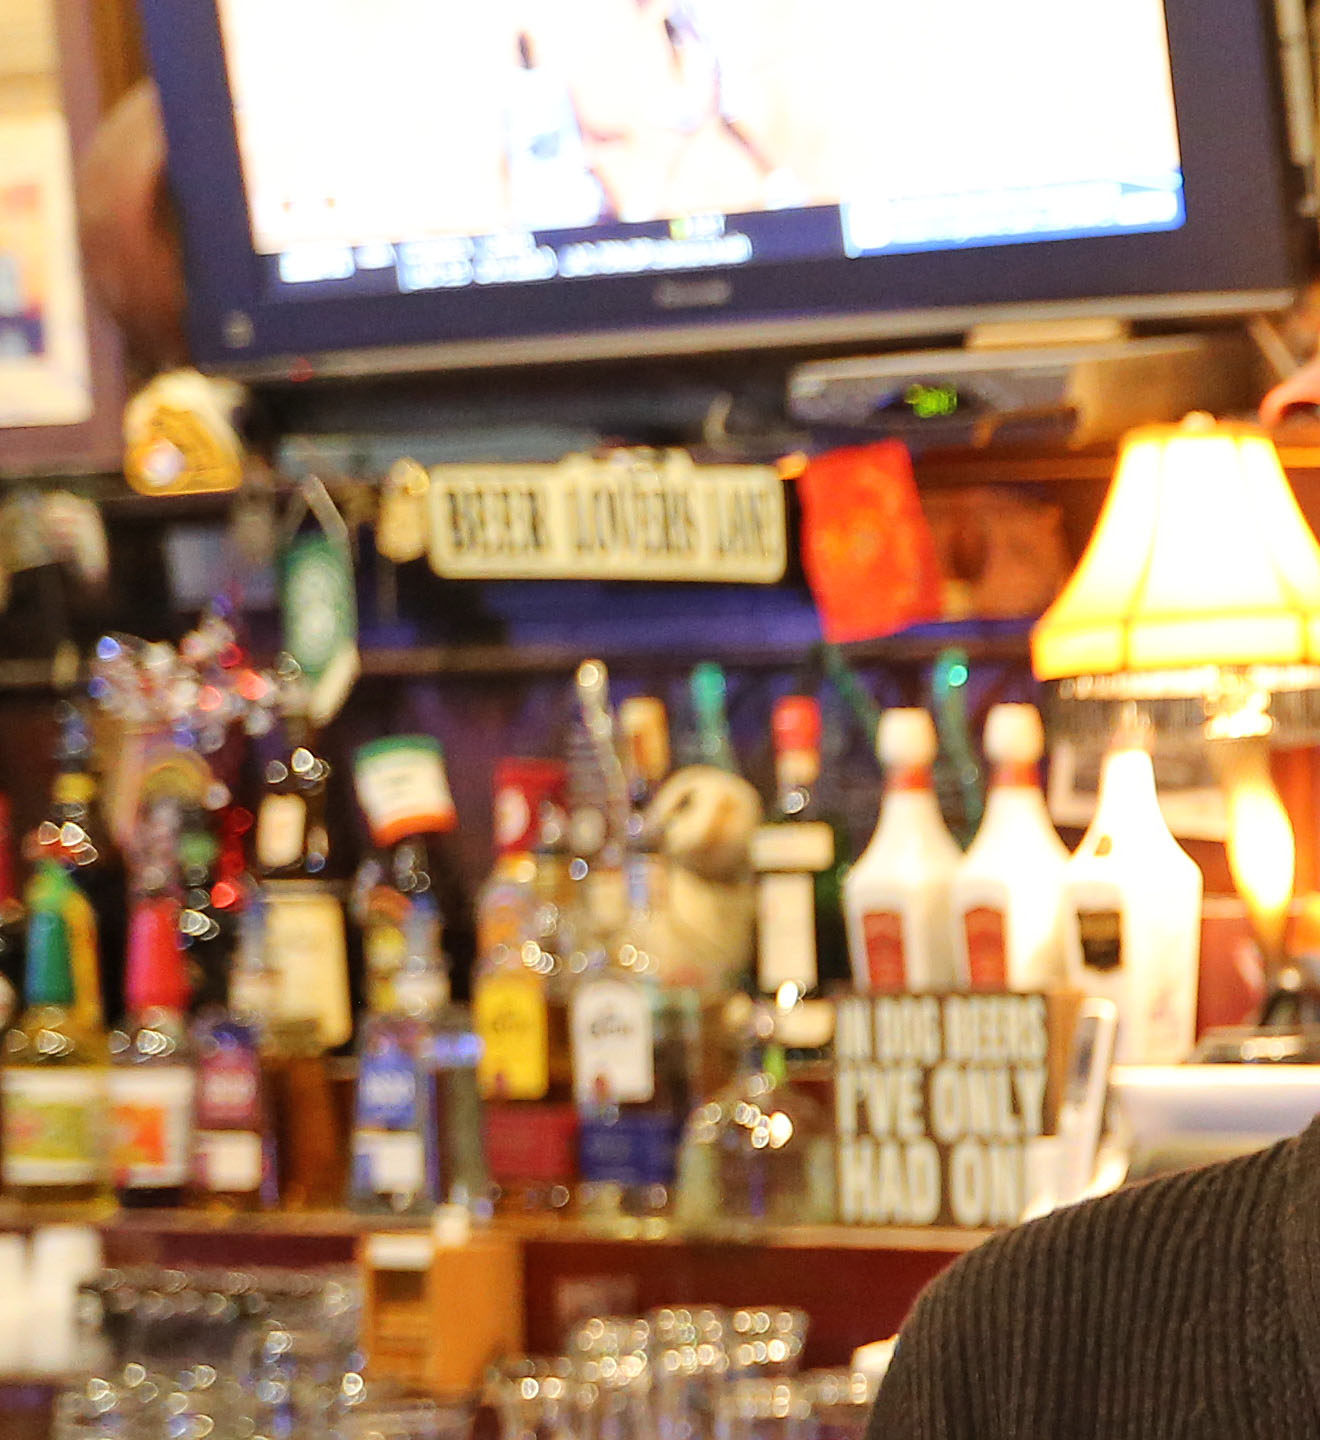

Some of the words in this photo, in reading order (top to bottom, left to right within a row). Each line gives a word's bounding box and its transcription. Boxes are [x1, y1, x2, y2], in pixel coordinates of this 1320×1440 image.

[445, 487, 549, 553] BEER
[944, 994, 1047, 1062] BEERS
[930, 1062, 1046, 1142] ONLY
[838, 1138, 941, 1227] HAD
[949, 1139, 1024, 1228] ON
